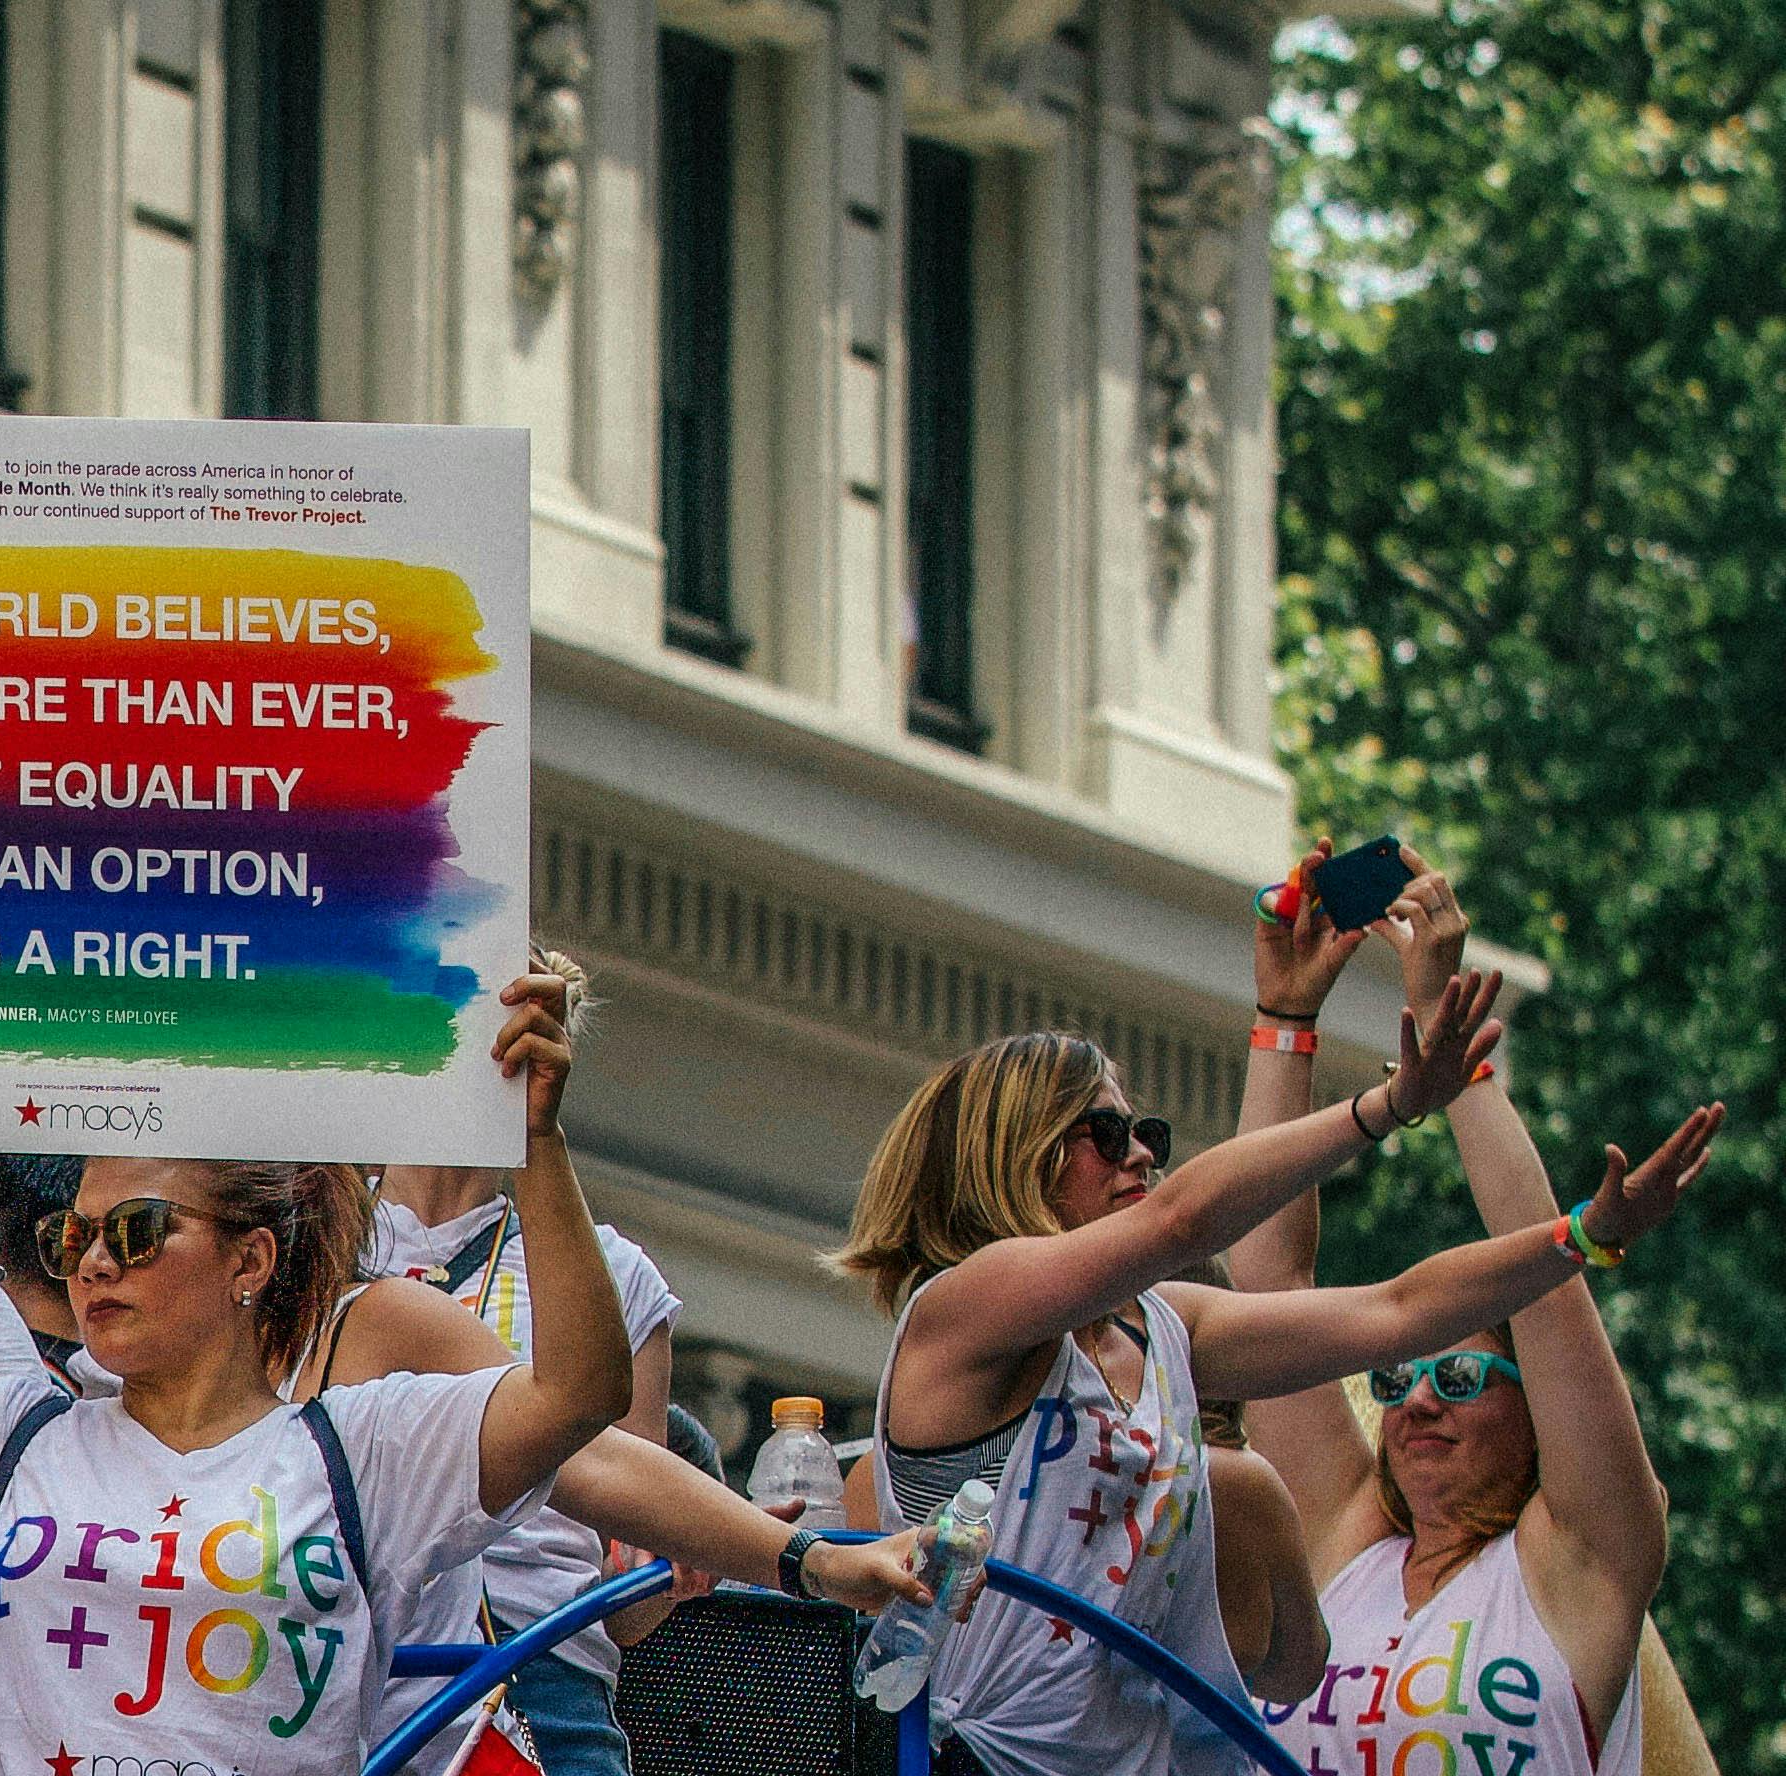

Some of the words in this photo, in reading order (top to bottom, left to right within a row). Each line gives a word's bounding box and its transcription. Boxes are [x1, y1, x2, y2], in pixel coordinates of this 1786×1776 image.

[5, 460, 21, 474] to
[24, 460, 52, 478] join
[58, 461, 82, 475] the
[86, 462, 141, 480] parade
[145, 465, 197, 479] across
[202, 464, 265, 480] America
[270, 463, 284, 479] in
[289, 464, 334, 481] honor
[339, 465, 355, 482] of
[18, 481, 75, 497] Month.
[80, 482, 105, 497] We
[110, 483, 147, 498] think
[152, 483, 174, 498] it's
[178, 484, 219, 502] really
[224, 486, 305, 505] something
[310, 488, 325, 502] to
[330, 488, 408, 504] celebrate.
[13, 504, 37, 518] our
[43, 504, 120, 519] continued
[124, 506, 185, 523] support
[190, 507, 207, 522] of
[210, 506, 241, 522] The
[246, 507, 298, 523] Trevor
[302, 508, 367, 527] Project.
[116, 593, 391, 655] BELIEVES,
[81, 678, 234, 727] THAN
[252, 681, 410, 741] EVER,
[20, 761, 305, 812] EQUALITY
[90, 846, 325, 908] OPTION,
[15, 930, 57, 977] A
[73, 930, 257, 982] RIGHT.
[47, 1007, 101, 1025] MACY'S
[106, 1009, 179, 1027] EMPLOYEE
[50, 1101, 163, 1140] macy's
